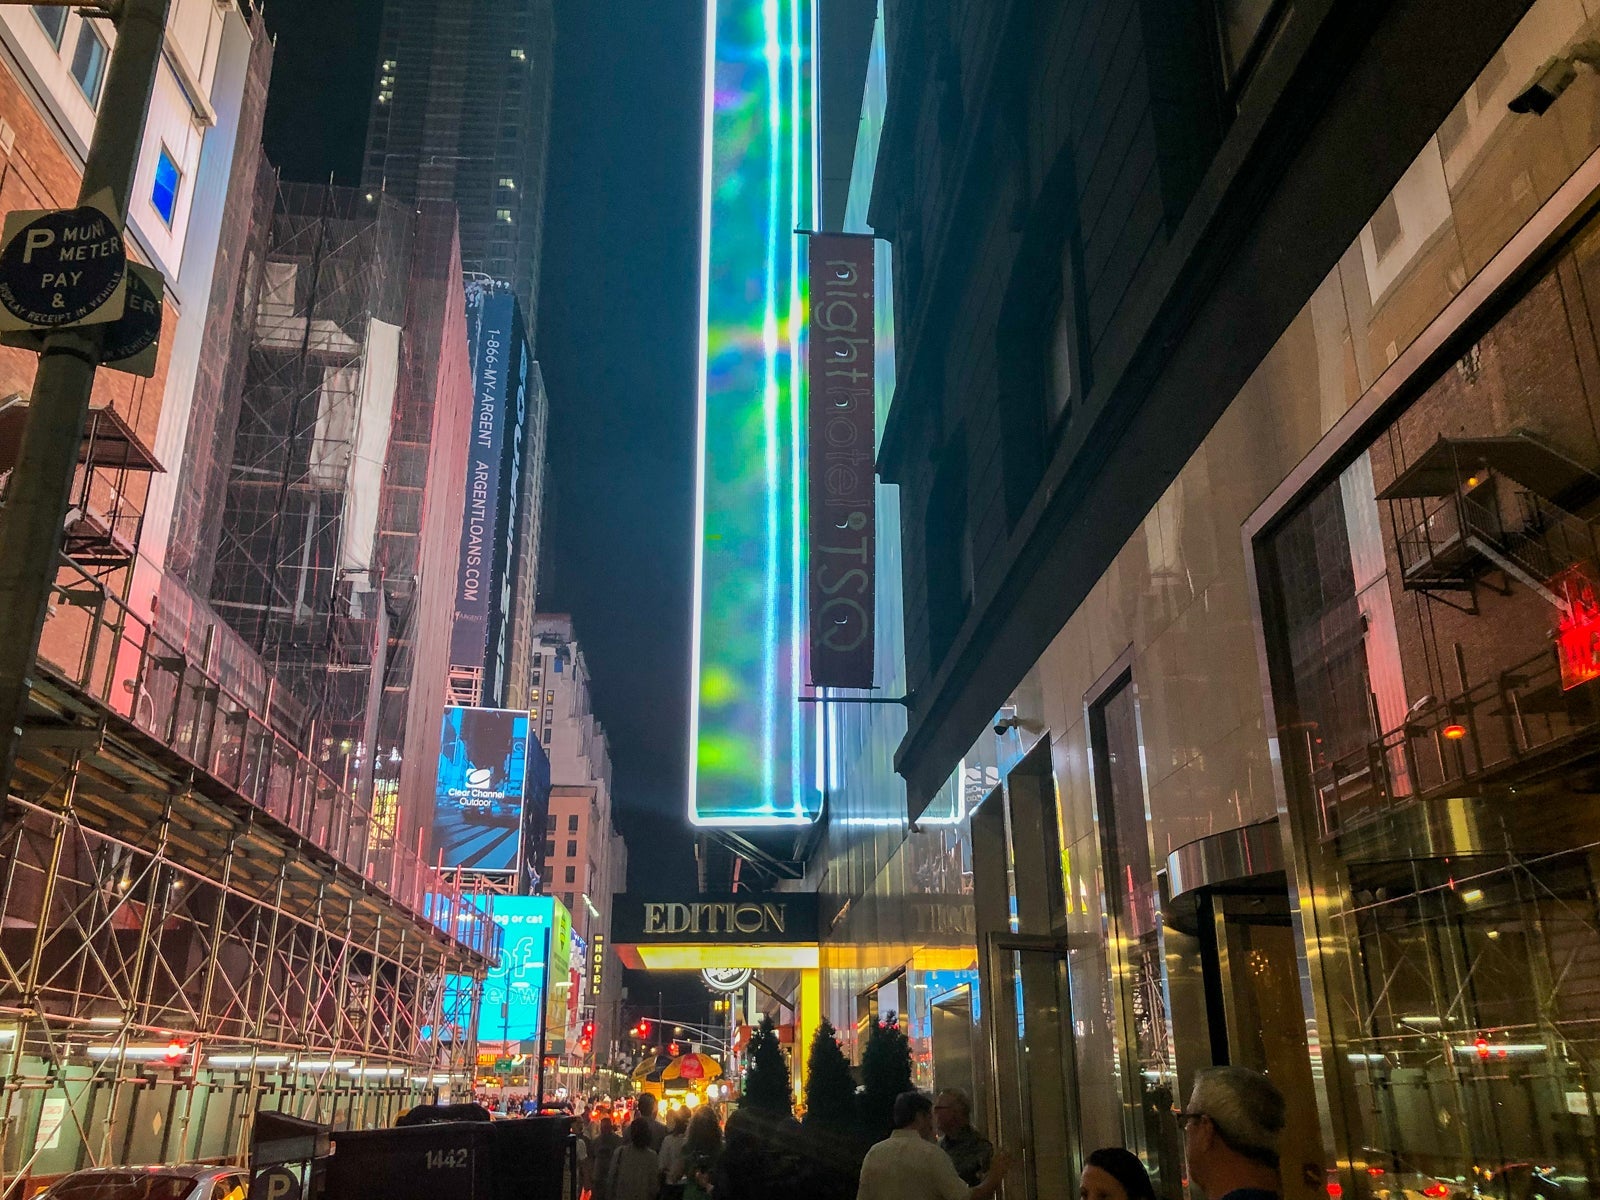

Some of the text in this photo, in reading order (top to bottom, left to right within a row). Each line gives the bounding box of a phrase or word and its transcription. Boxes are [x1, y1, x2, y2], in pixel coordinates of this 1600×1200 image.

[22, 228, 55, 264] P
[59, 236, 121, 262] METER
[41, 271, 83, 289] PAY
[52, 293, 65, 308] &
[27, 311, 71, 323] RECEIPT
[75, 306, 87, 317] IN
[463, 329, 501, 602] 1-866-MY-ARGENT ARGENTLOANS.COM
[448, 788, 505, 799] Clear Channel
[459, 797, 492, 807] Outdoor
[490, 914, 508, 925] og
[511, 914, 523, 924] or
[526, 914, 543, 924] cat
[642, 902, 787, 934] EDITION
[592, 943, 603, 995] HOTEL
[483, 988, 539, 1005] eow
[425, 1149, 467, 1169] 1442
[267, 1174, 290, 1200] P
